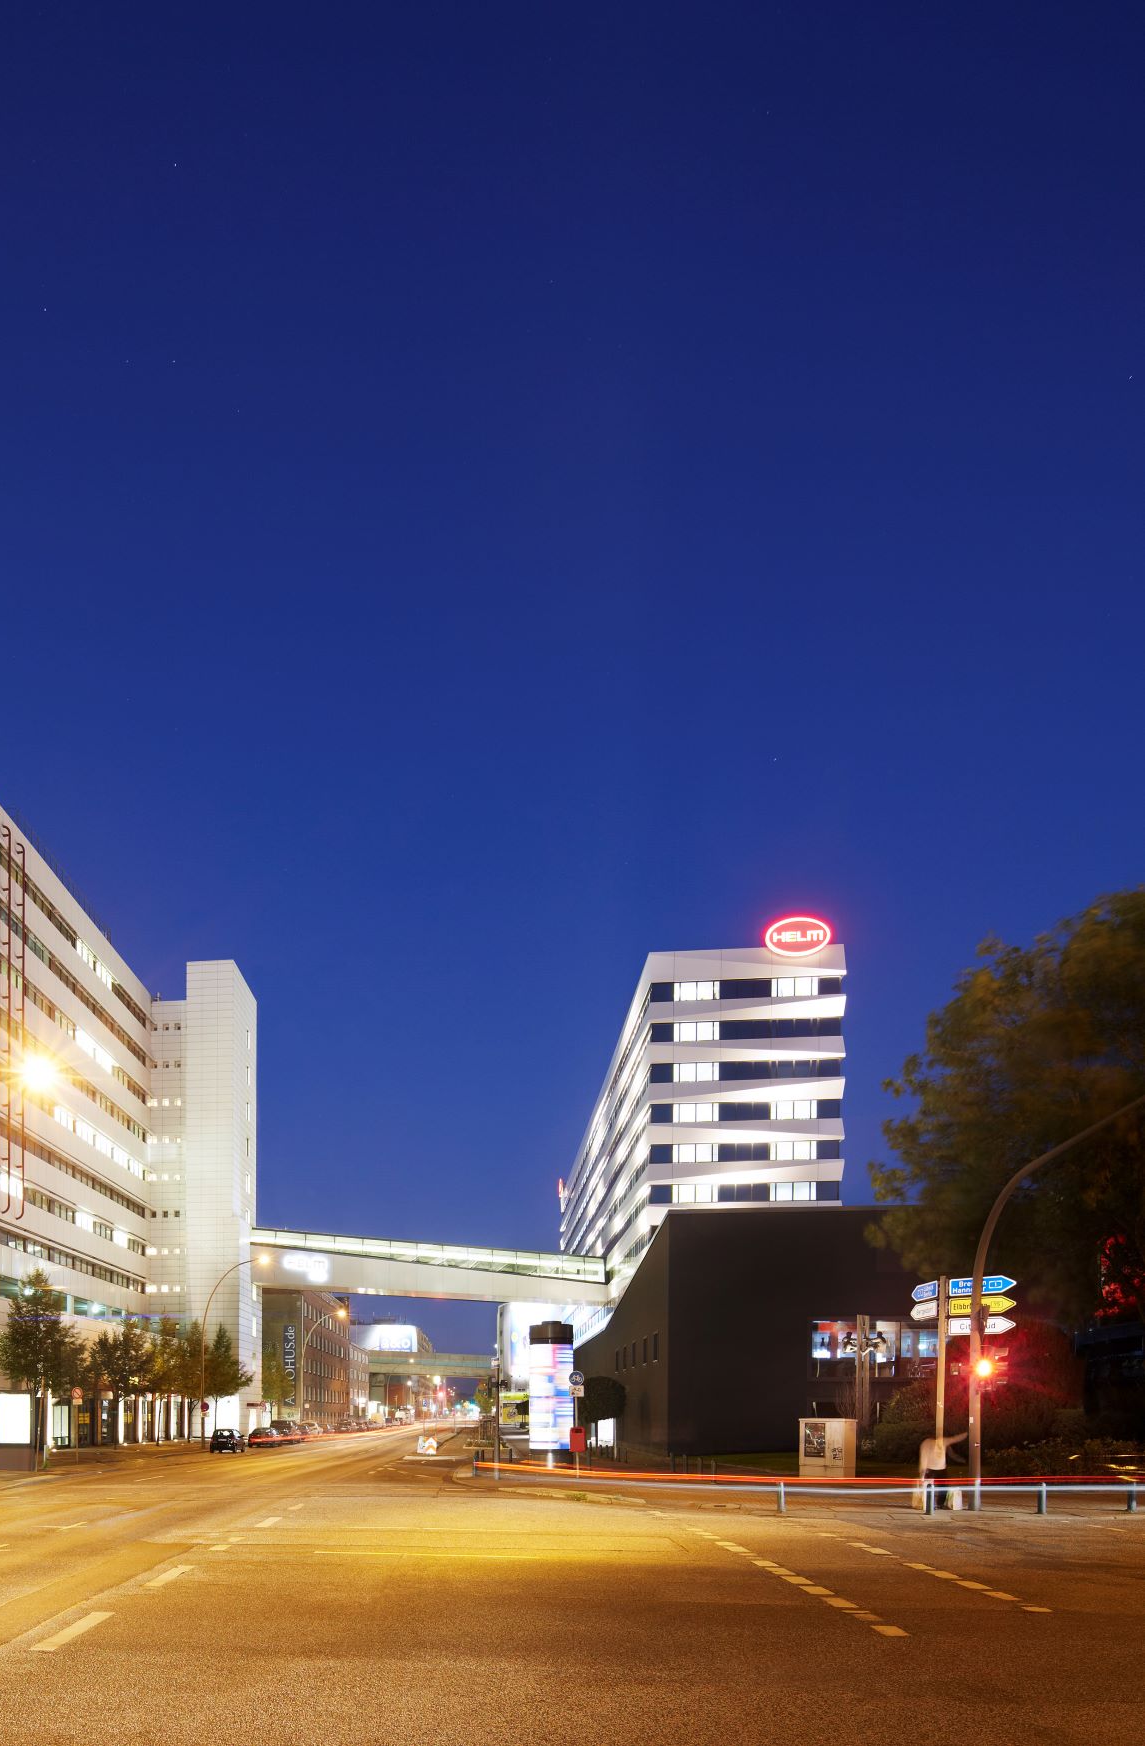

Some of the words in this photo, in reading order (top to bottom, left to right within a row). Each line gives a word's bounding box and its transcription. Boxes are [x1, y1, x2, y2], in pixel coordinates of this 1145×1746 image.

[772, 929, 824, 943] HELM
[958, 1280, 987, 1288] Bren
[952, 1286, 987, 1294] Hannr
